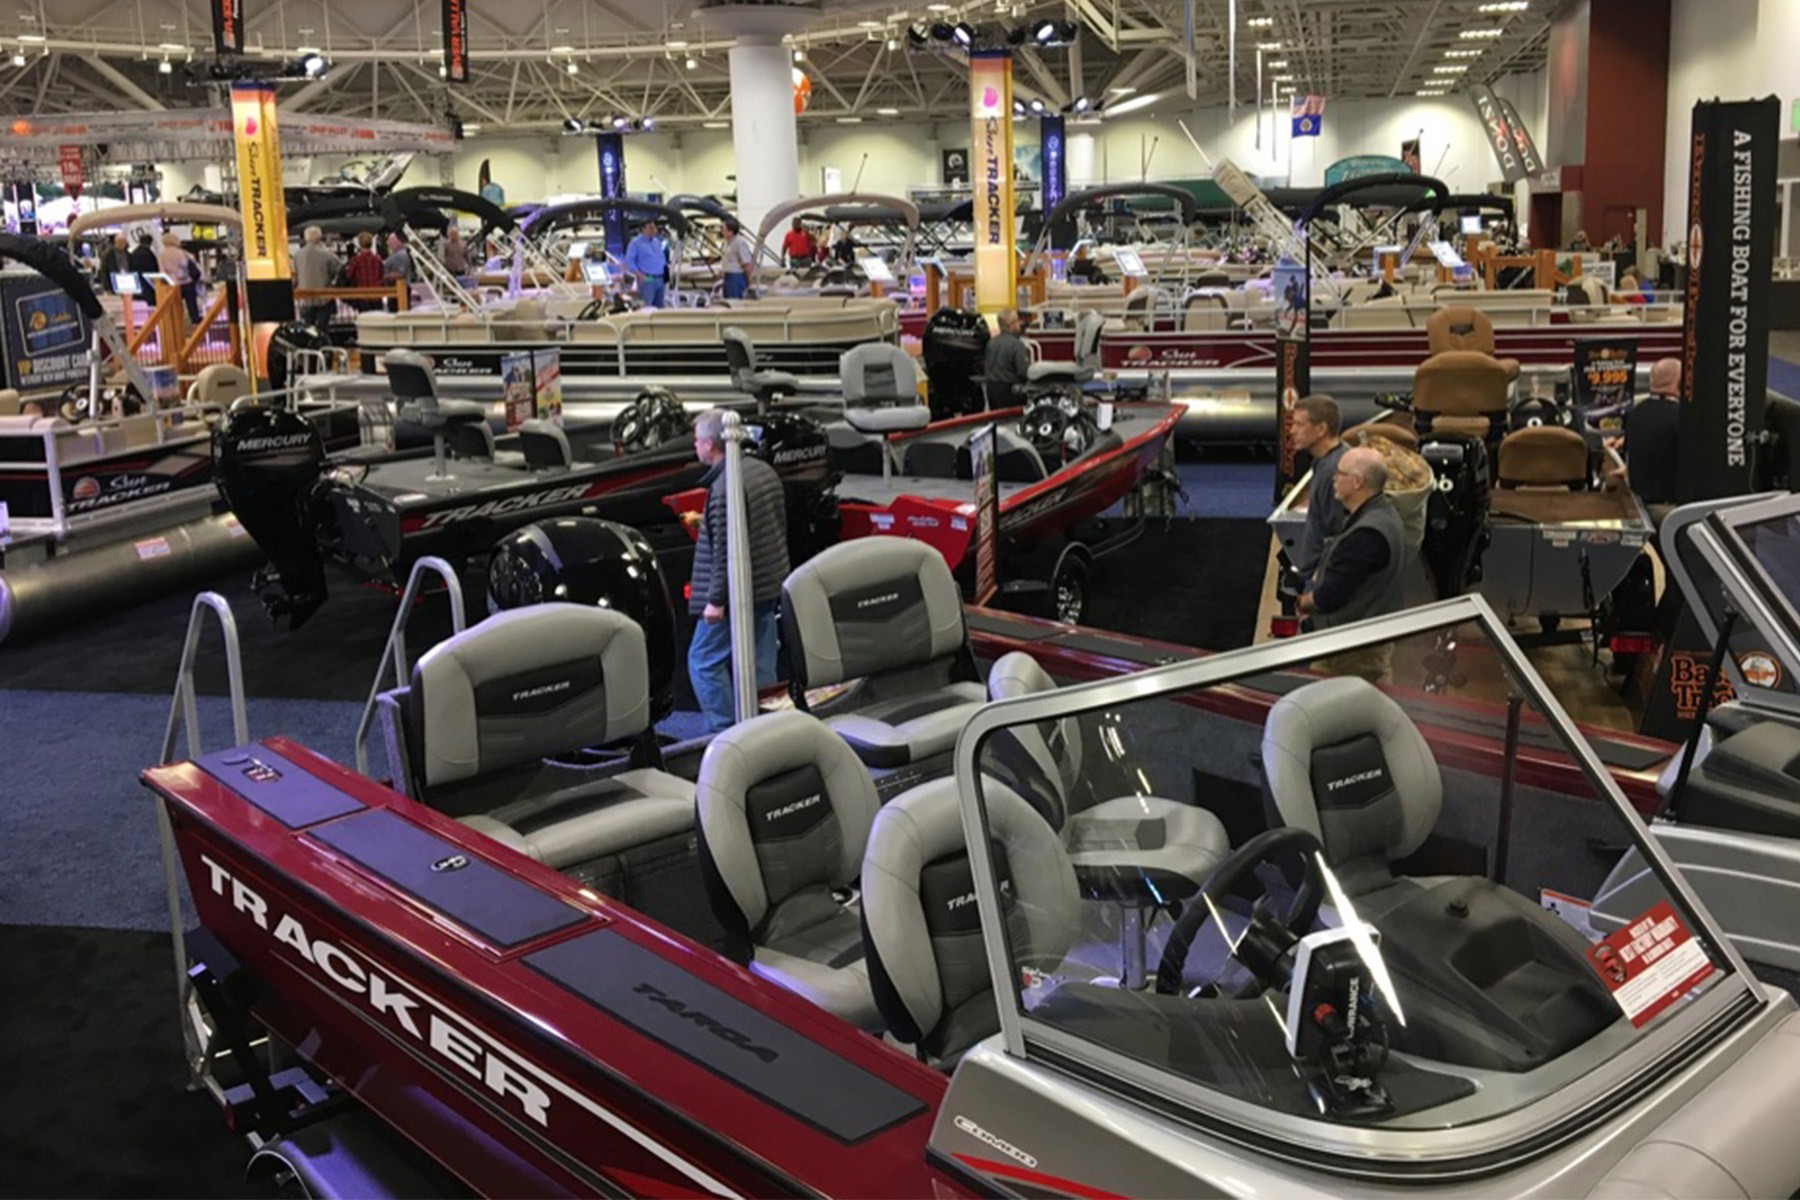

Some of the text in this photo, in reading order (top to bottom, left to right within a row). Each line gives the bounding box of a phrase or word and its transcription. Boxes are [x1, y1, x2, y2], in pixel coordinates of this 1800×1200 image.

[987, 156, 1001, 245] TRACKER
[251, 177, 268, 258] TRACKER
[1727, 130, 1752, 467] A FISHING BOAT FOR EVERYONE
[433, 367, 493, 375] ACKER
[1120, 359, 1221, 367] TRACKER
[236, 432, 312, 452] MERCURY
[773, 444, 827, 465] MERCURY
[67, 481, 172, 512] TRACKER
[421, 483, 594, 529] TRACKER
[857, 592, 899, 609] TRACKER
[511, 680, 571, 702] TRACKER
[1327, 768, 1383, 791] TRACKER
[766, 794, 822, 822] TRACKER
[947, 879, 1009, 911] TRAR
[200, 853, 552, 1128] TRACKER
[632, 982, 780, 1064] TARGA
